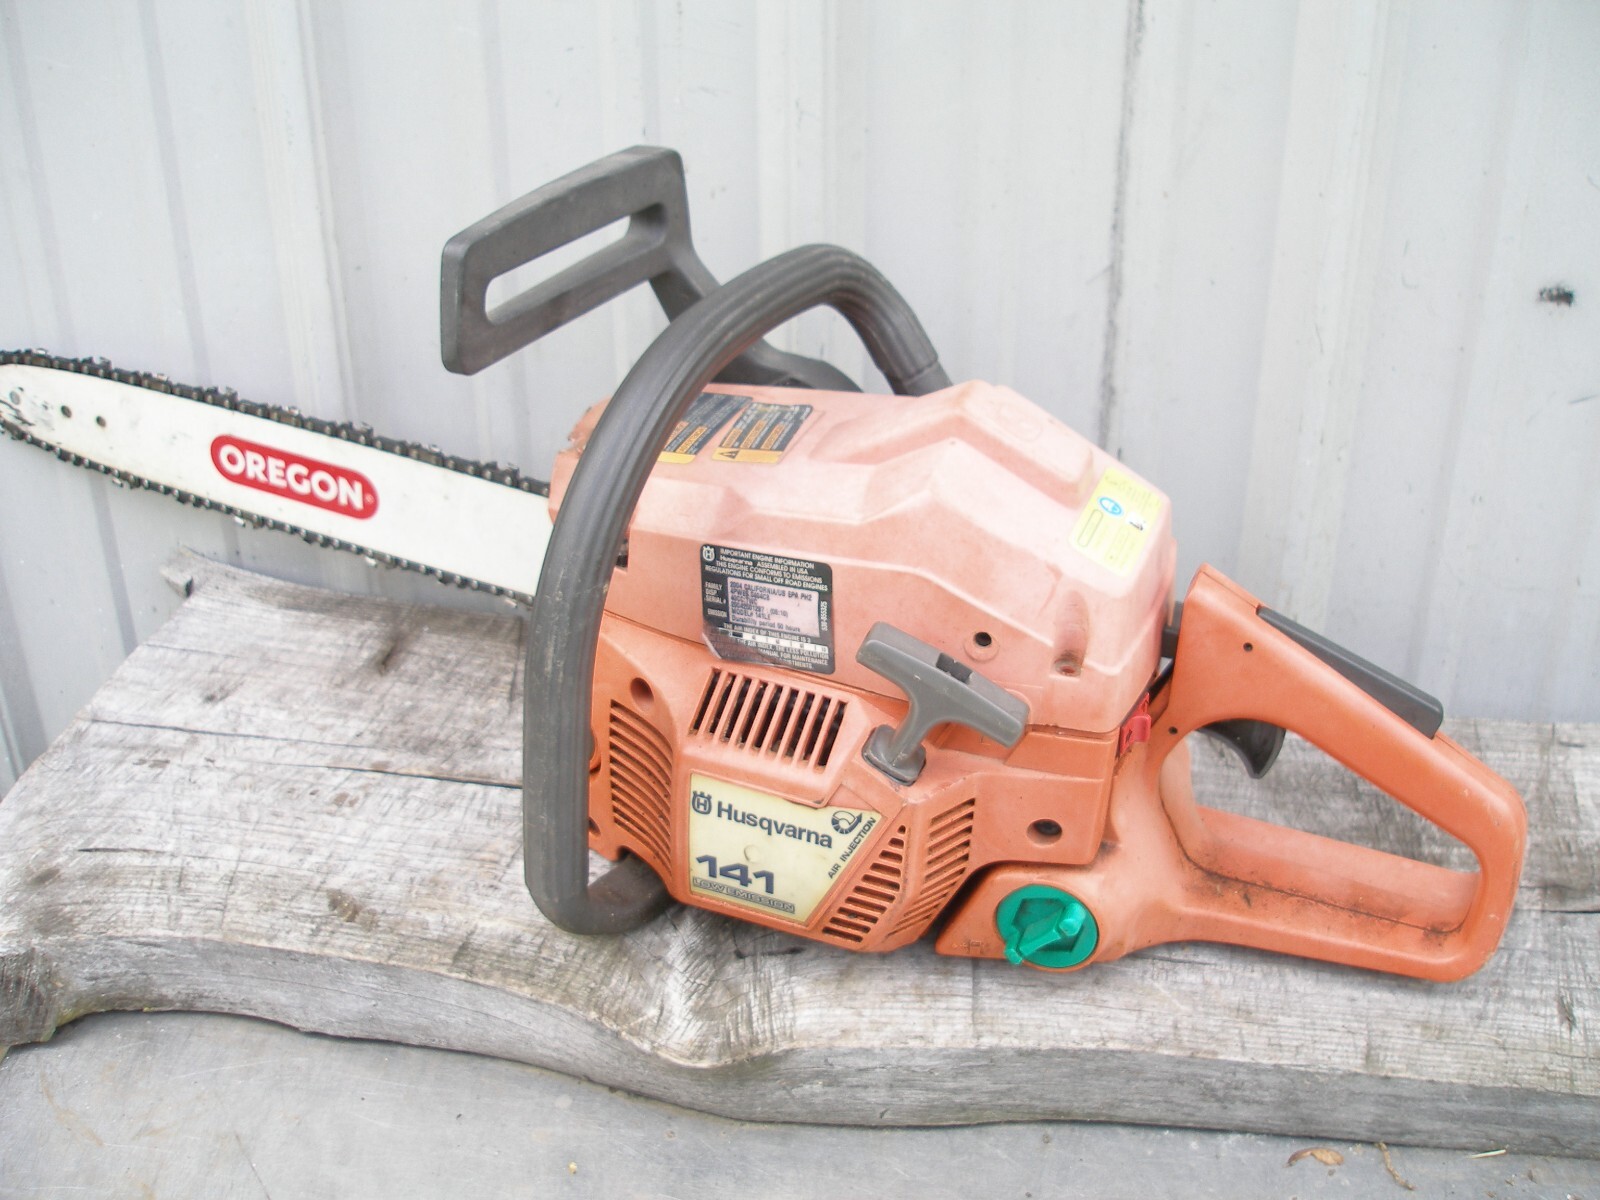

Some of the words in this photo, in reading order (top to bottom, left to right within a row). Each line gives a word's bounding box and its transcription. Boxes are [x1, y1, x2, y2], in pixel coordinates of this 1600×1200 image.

[219, 443, 365, 511] OREGON
[716, 560, 727, 568] THIS
[728, 562, 749, 572] ENGINE
[750, 566, 783, 577] CONFORMS
[783, 571, 792, 579] TO
[792, 573, 823, 584] EMISSIONS
[720, 548, 752, 559] IMPORTANT
[752, 553, 773, 563] ENGINE
[774, 556, 815, 569] INFORMATION
[757, 561, 789, 572] ASSEMBLED
[797, 567, 809, 575] USA
[705, 565, 741, 577] REGULATIONS
[742, 571, 754, 579] FOR
[755, 574, 772, 583] SMALL
[773, 577, 784, 585] OFF
[785, 579, 802, 588] ROAD
[803, 581, 829, 592] ENGINES
[717, 801, 834, 849] Husqvarna
[827, 864, 842, 880] AIR
[839, 817, 877, 862] INJECTION
[696, 854, 775, 895] 141
[725, 885, 795, 914] EMISSION
